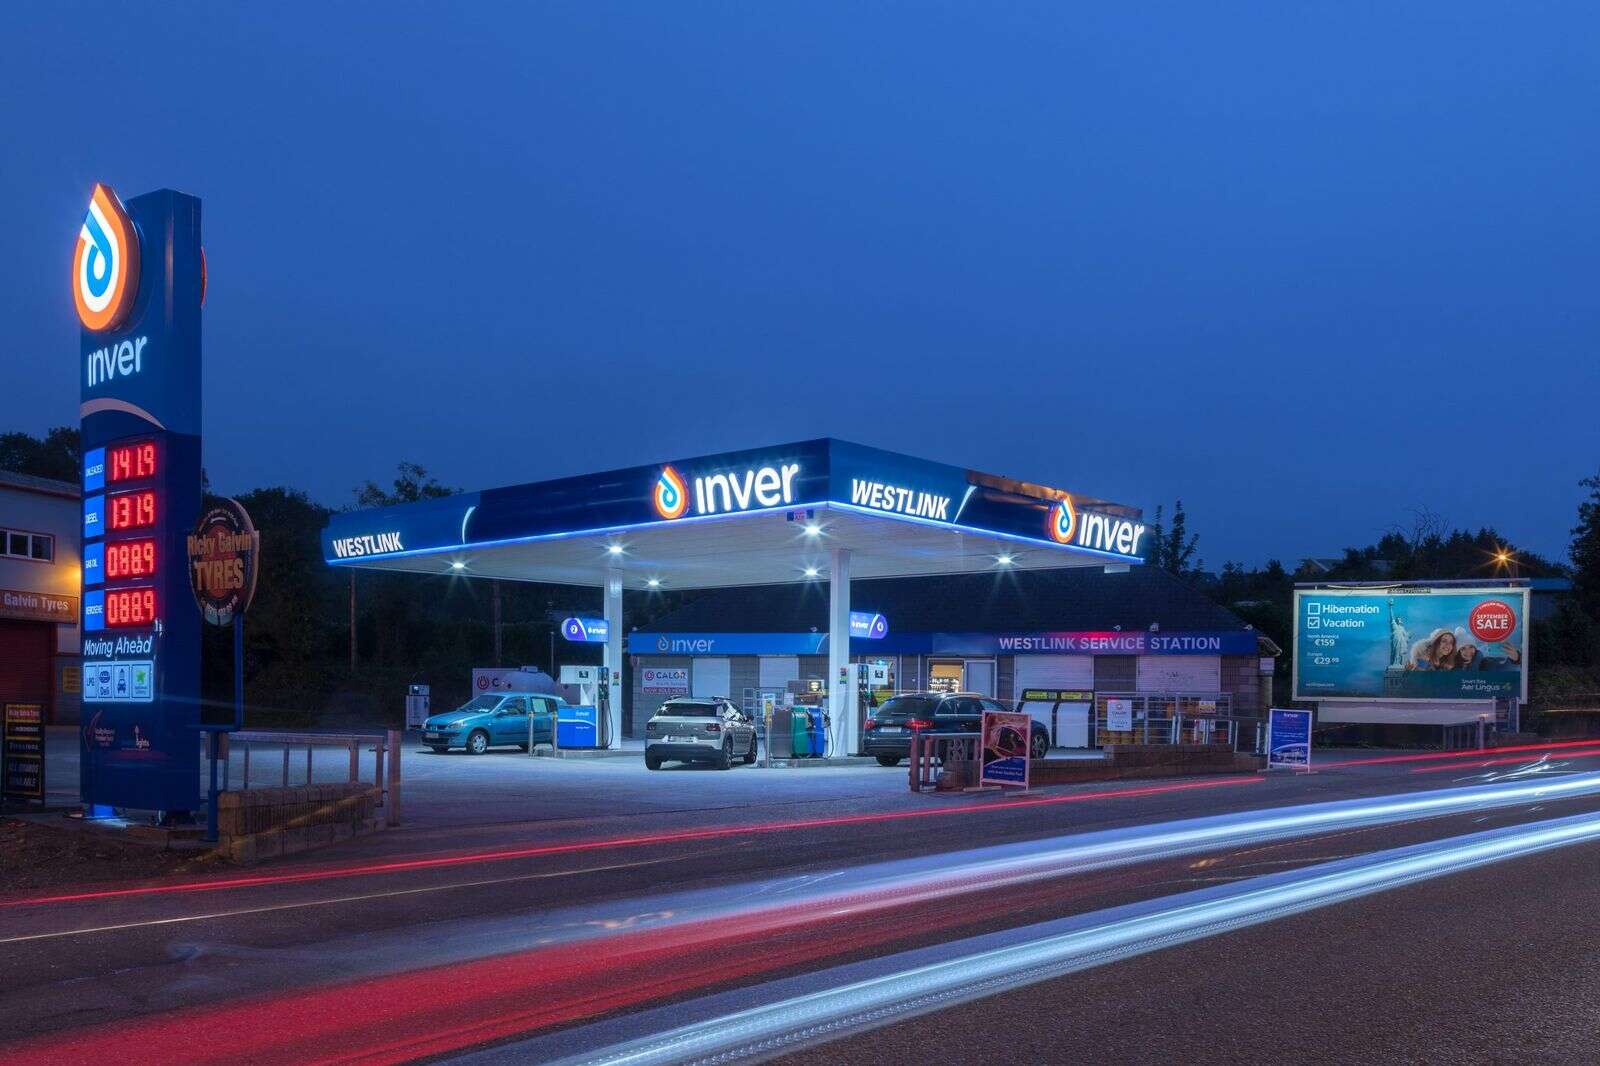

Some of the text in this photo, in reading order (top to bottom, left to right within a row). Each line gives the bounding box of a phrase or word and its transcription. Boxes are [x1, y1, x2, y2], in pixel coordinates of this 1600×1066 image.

[87, 335, 148, 388] inver
[695, 462, 799, 514] inver
[852, 478, 950, 520] WESTLINK
[1078, 512, 1146, 555] inver
[332, 531, 404, 558] WESTLINK
[194, 558, 244, 591] TYRES
[4, 592, 69, 612] Galvin Tyres
[1322, 604, 1380, 614] Hibernation
[1323, 618, 1365, 628] Vacation
[1476, 619, 1508, 629] SALE
[84, 635, 153, 658] Moving Ahead
[672, 639, 715, 651] inver
[999, 637, 1221, 650] WESTLINK SERVICE STATION
[656, 671, 686, 680] CALOR
